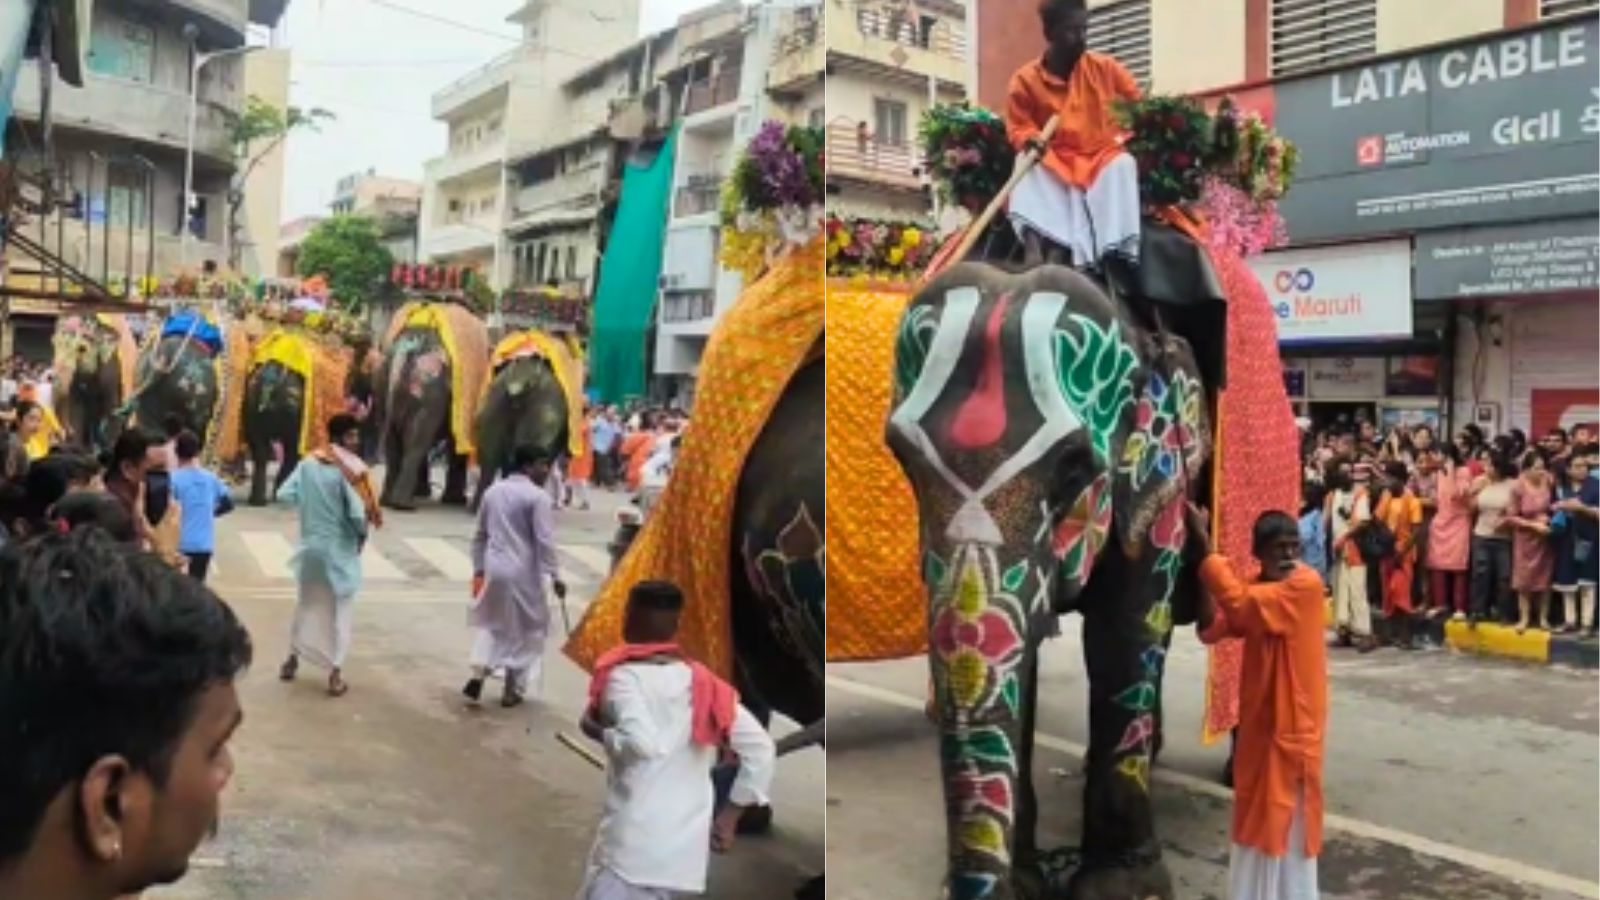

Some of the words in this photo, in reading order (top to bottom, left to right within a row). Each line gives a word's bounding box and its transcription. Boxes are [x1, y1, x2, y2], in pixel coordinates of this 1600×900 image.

[1331, 59, 1427, 108] LATA
[1438, 27, 1587, 88] CABLE
[1385, 131, 1470, 153] AUTOMATION
[1294, 293, 1361, 317] Maruti
